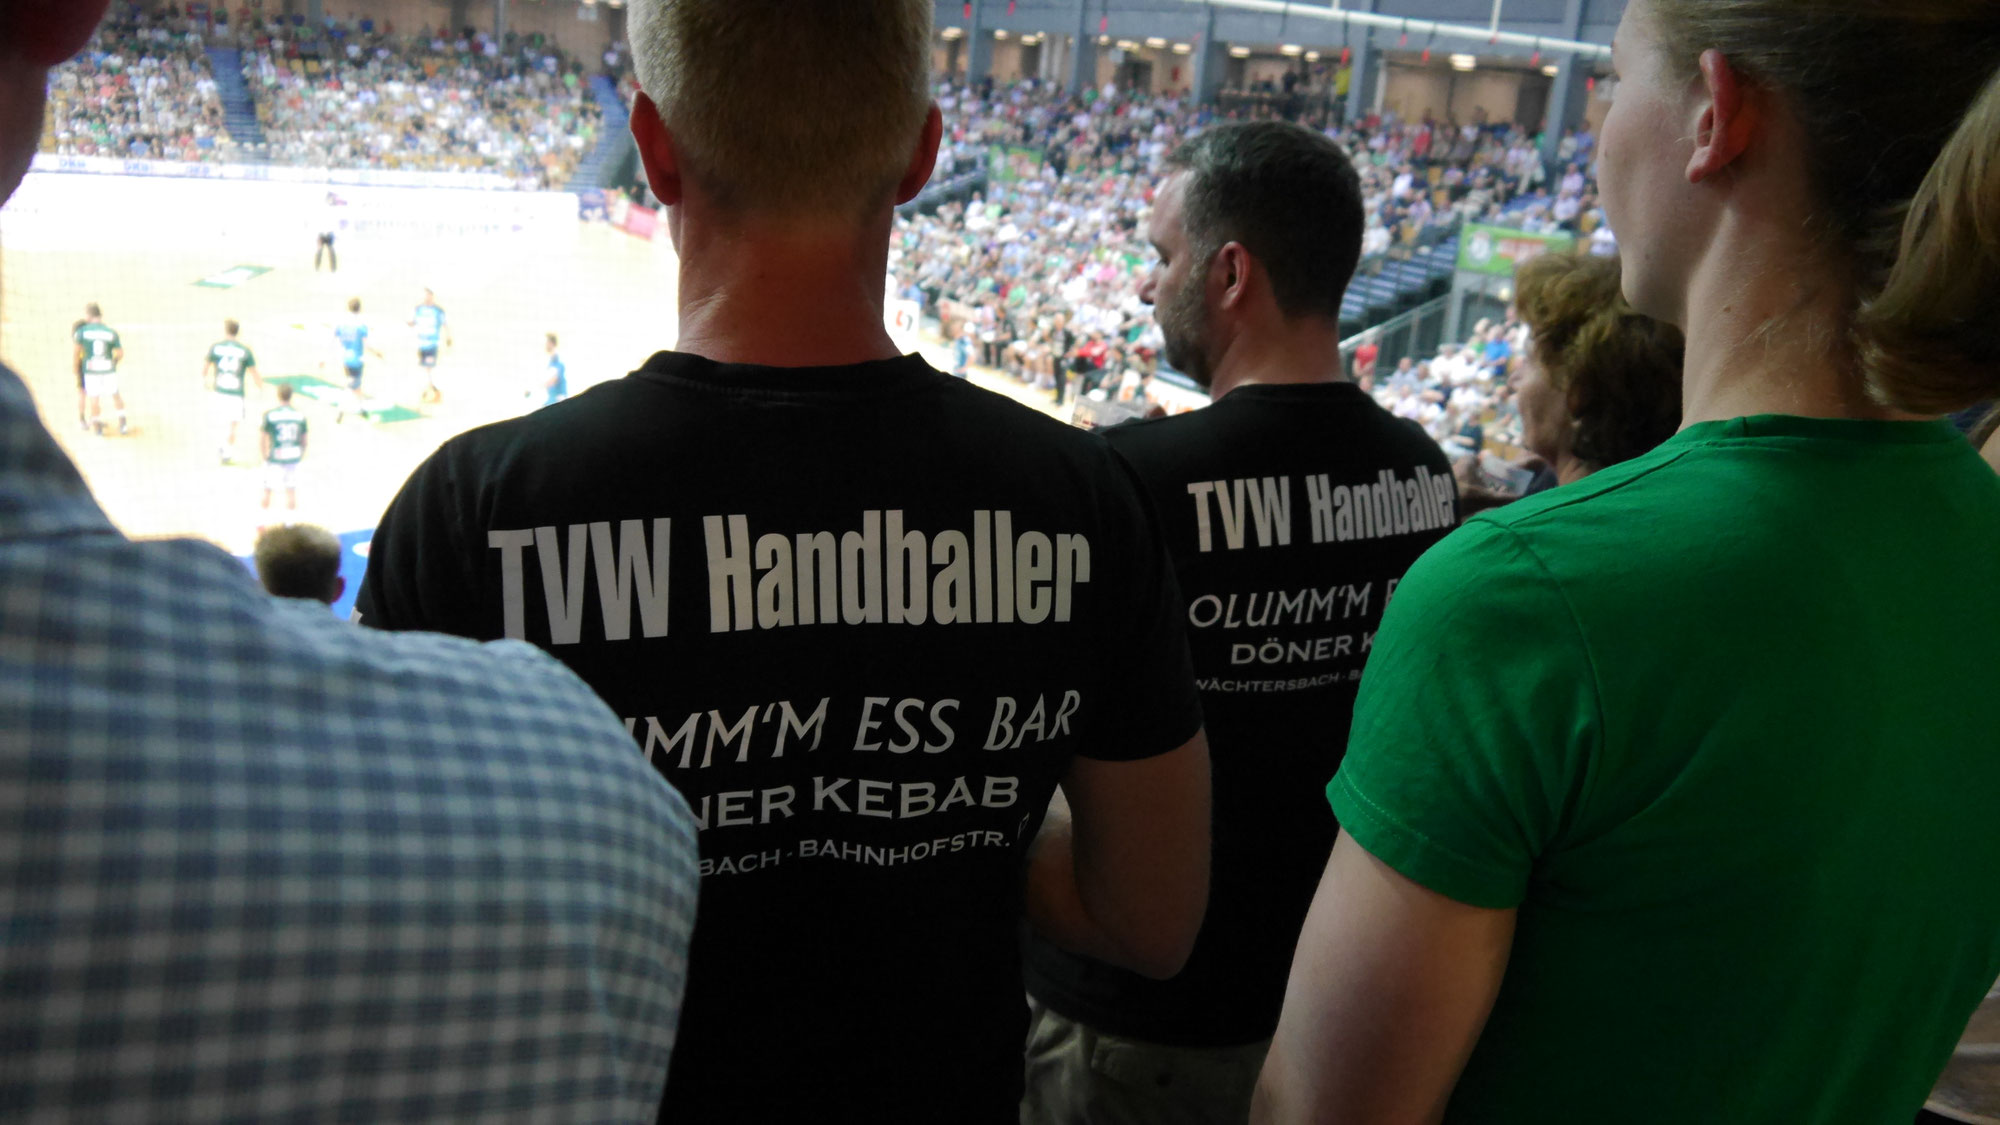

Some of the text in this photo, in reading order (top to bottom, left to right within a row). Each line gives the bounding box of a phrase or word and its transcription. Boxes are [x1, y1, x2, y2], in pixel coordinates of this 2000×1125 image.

[1187, 465, 1456, 552] TVW Handballer
[487, 509, 1091, 645] TVW Handballer
[1230, 634, 1352, 665] DÖNER
[853, 696, 960, 754] ESS
[984, 690, 1081, 751] BAR
[812, 776, 1020, 819] KEBAB
[799, 830, 1011, 867] BAHNHOFSTR.
